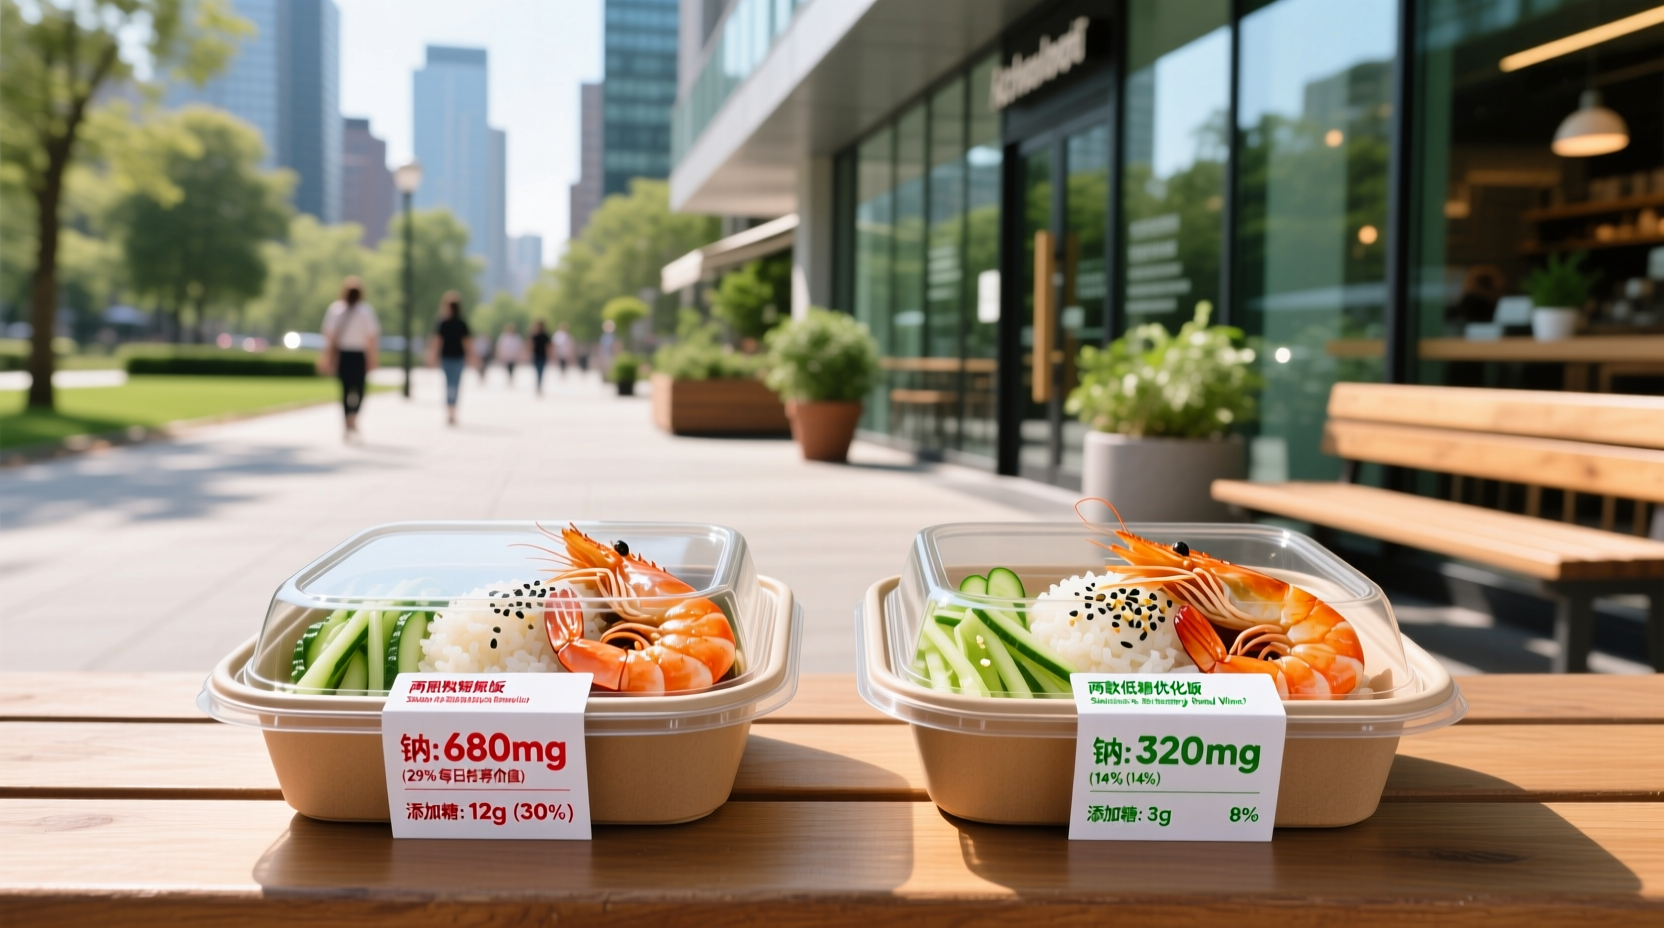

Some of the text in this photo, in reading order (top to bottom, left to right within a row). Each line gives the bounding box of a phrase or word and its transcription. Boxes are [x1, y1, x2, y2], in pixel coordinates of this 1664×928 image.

[1089, 771, 1161, 786] (14% (14%)
[468, 802, 507, 826] 12g
[513, 802, 574, 823] (30%)
[1147, 806, 1172, 827] 3g
[1229, 806, 1259, 822] 8%
